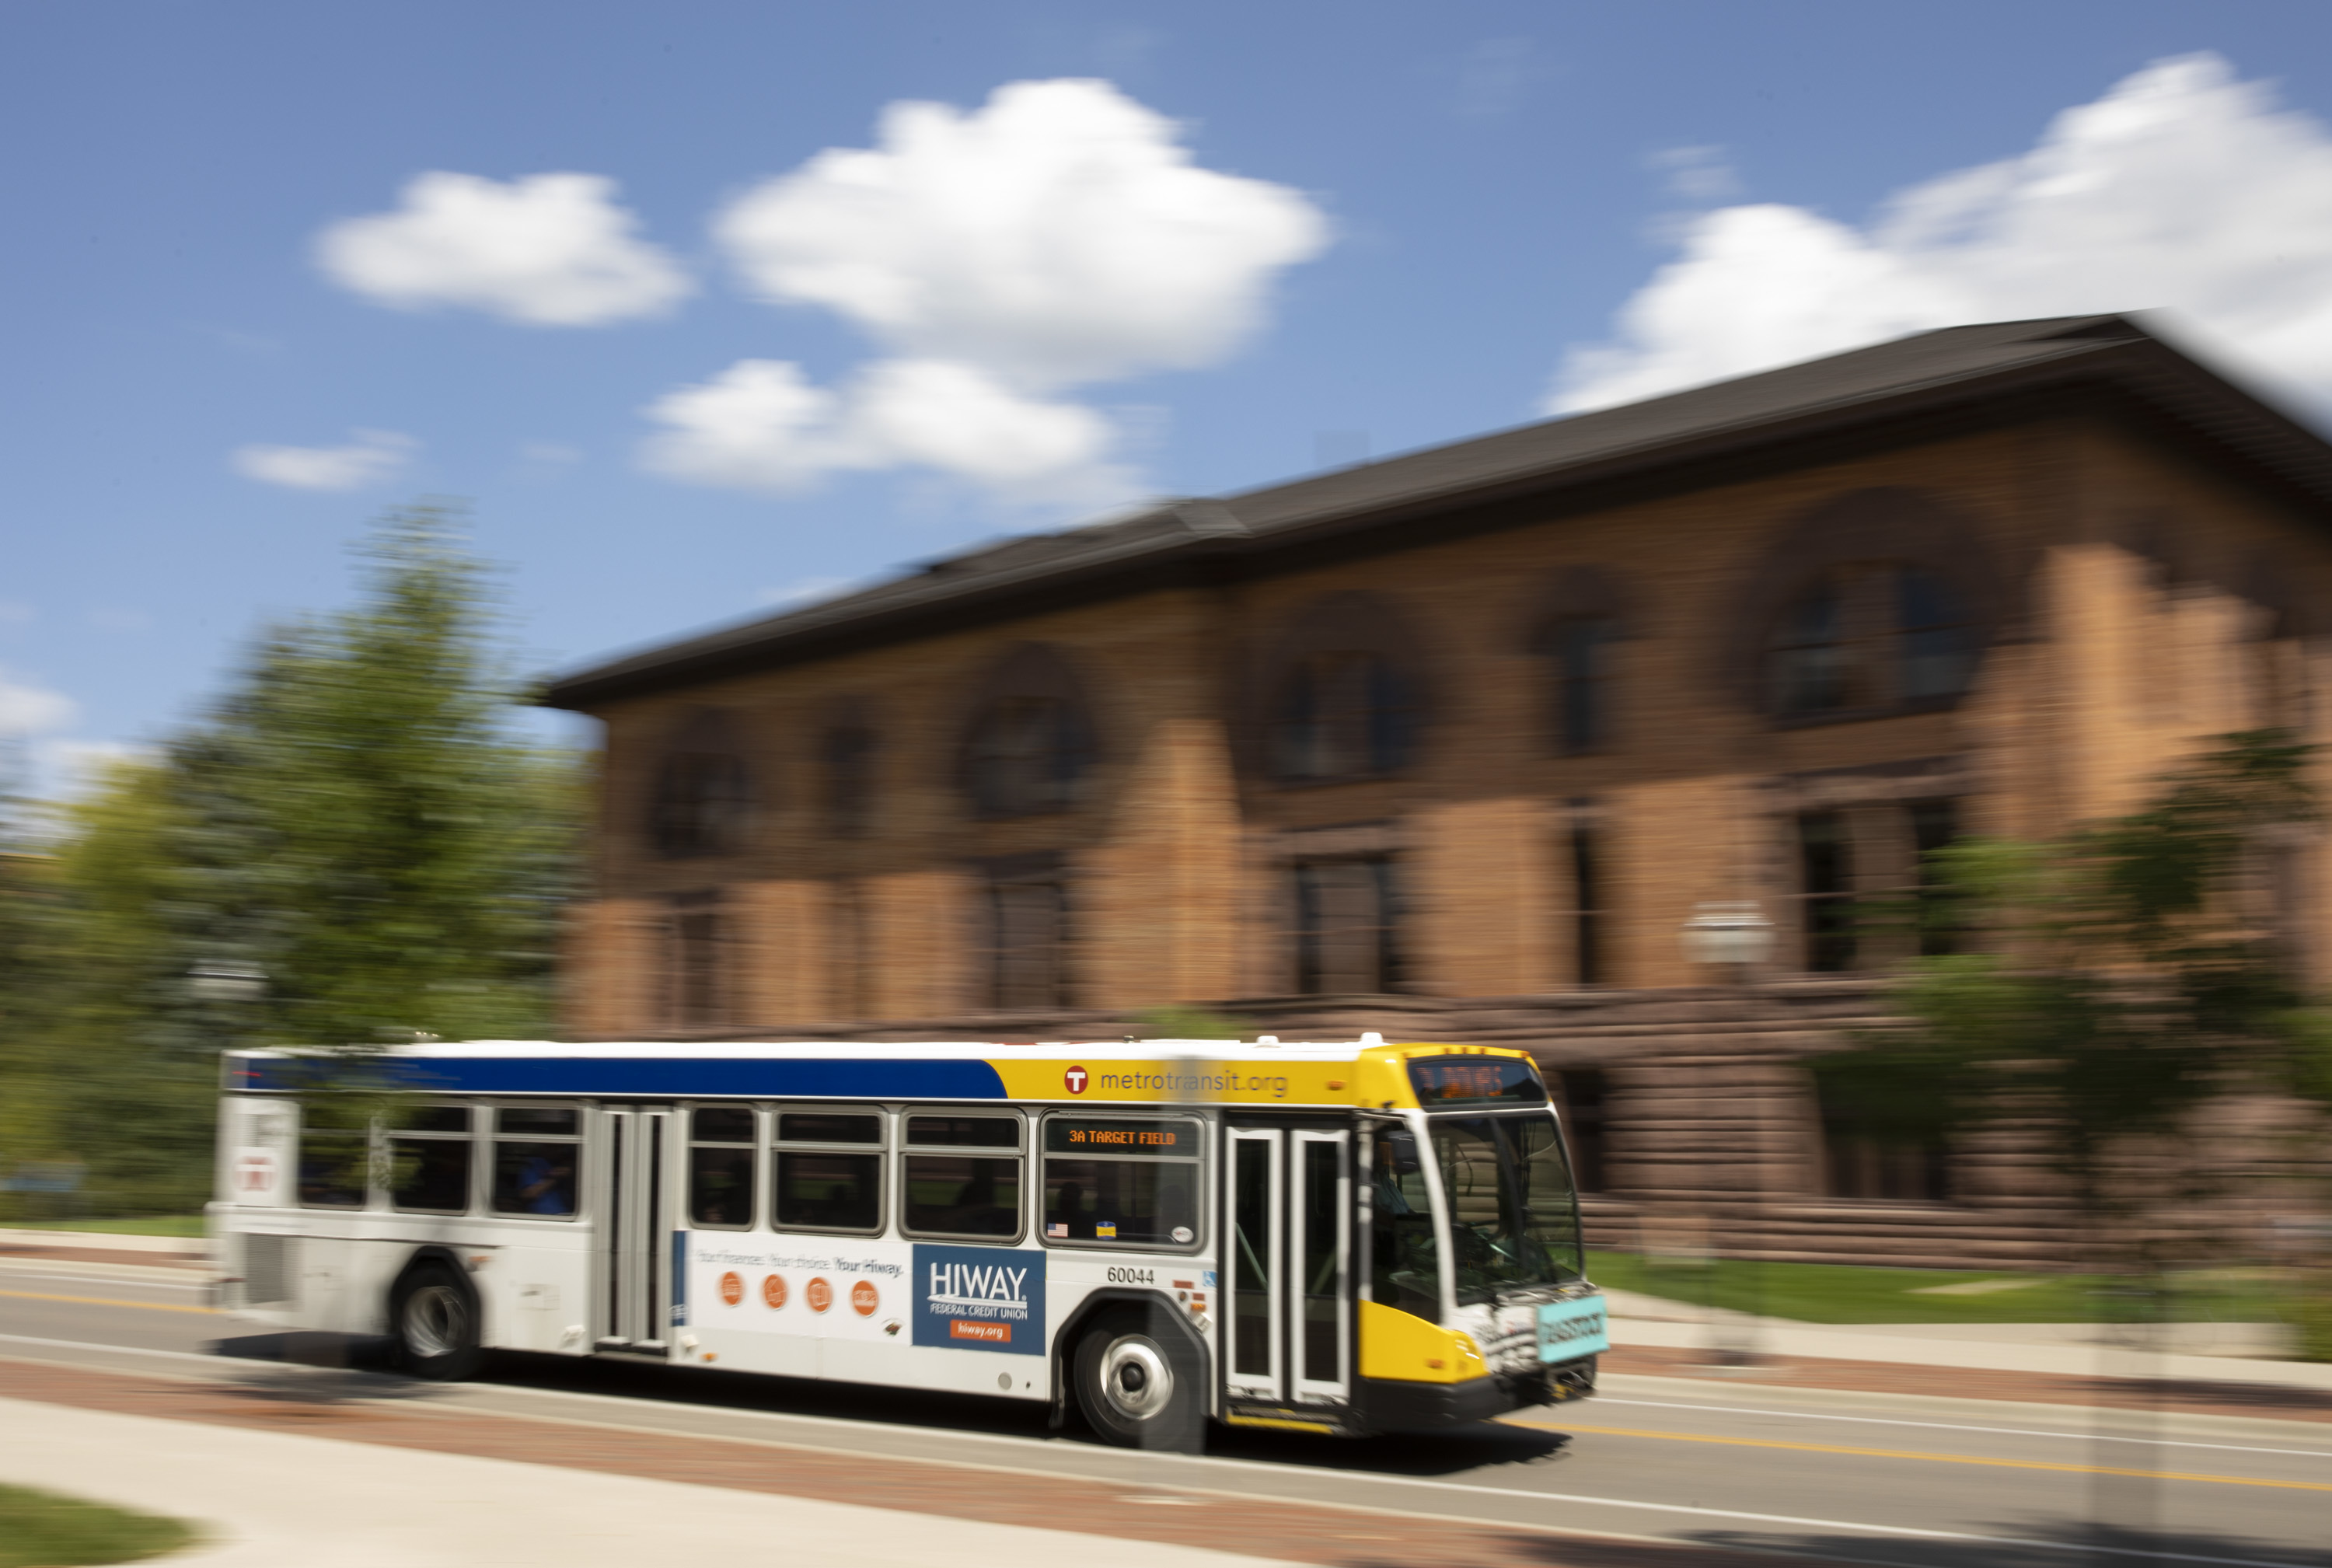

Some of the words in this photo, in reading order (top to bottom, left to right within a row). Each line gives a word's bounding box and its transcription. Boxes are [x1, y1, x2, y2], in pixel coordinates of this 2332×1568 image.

[1101, 1070, 1289, 1098] metrotransit.org
[1069, 1130, 1086, 1143] 3A
[1088, 1130, 1136, 1144] TARGET
[1139, 1132, 1176, 1145] FIELD
[835, 1257, 861, 1272] Your
[864, 1259, 904, 1279] Hiway.
[1108, 1266, 1155, 1284] 60044
[930, 1262, 1028, 1301] HIWAY
[930, 1302, 968, 1317] FEDERAL
[968, 1305, 999, 1319] CREDIT
[1000, 1308, 1028, 1320] UNION
[958, 1322, 1004, 1339] hiway.org
